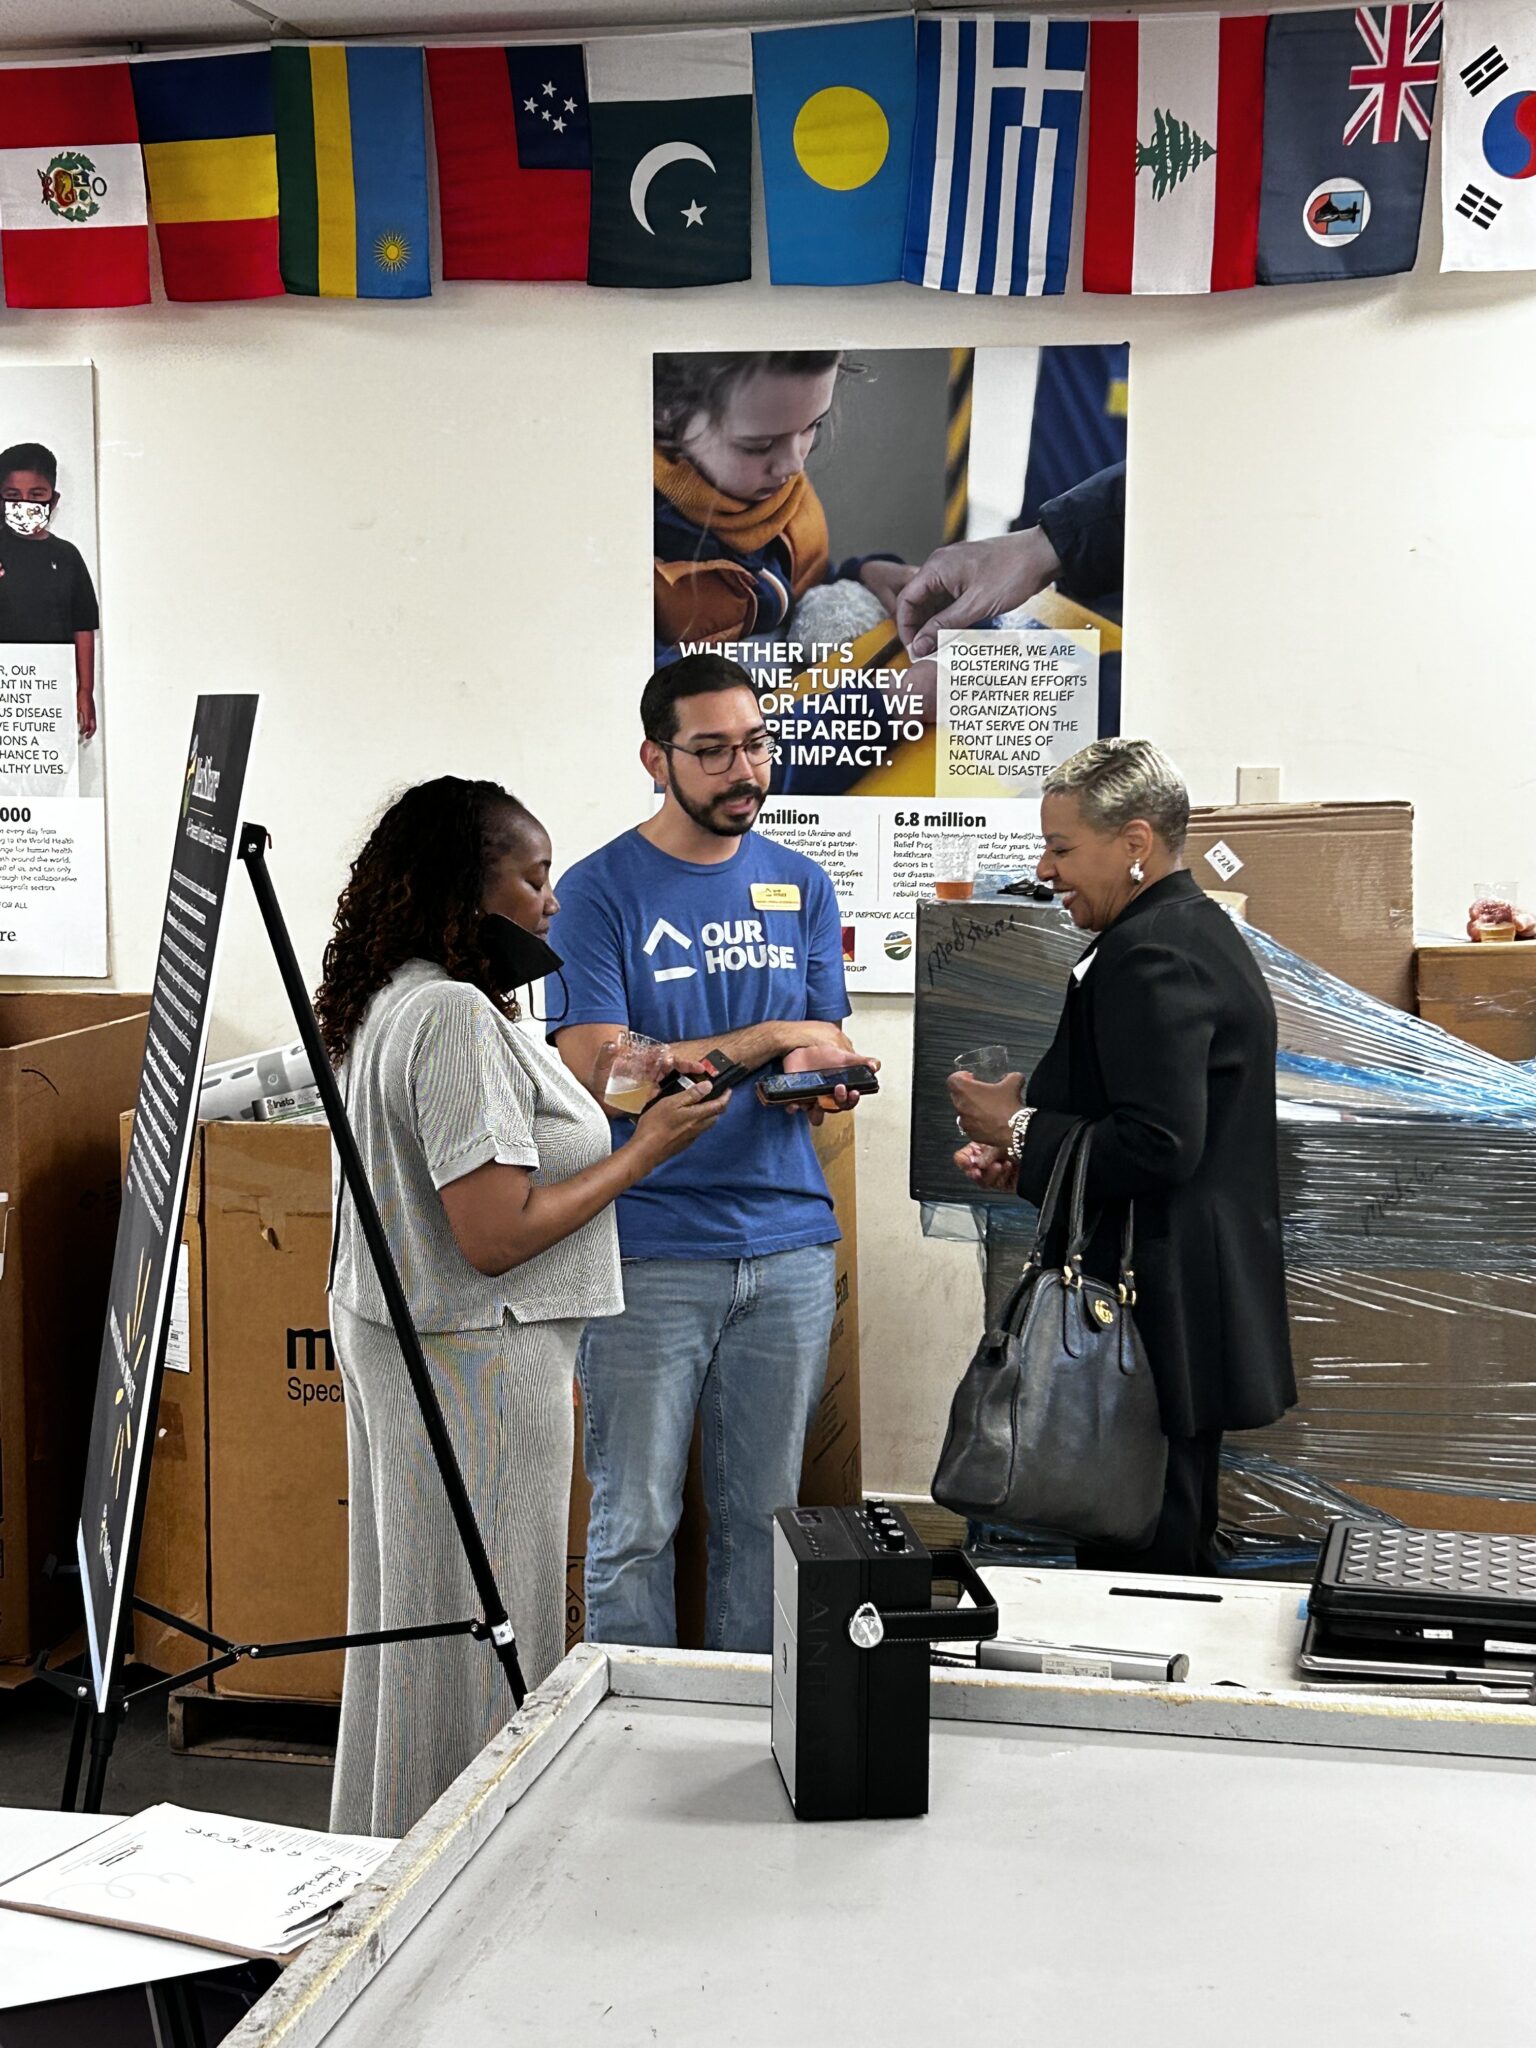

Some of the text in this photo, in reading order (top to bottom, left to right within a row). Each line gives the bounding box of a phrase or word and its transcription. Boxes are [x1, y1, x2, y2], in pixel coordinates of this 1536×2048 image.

[679, 641, 854, 664] WHETHER IT'S
[950, 645, 1076, 657] TOGETHER, WE ARE
[11, 665, 36, 676] OUR
[950, 660, 1059, 671] BOLSTERING THE
[20, 679, 32, 690] IN
[35, 679, 58, 690] THE
[807, 668, 913, 692] TURKEY,
[950, 675, 1087, 687] HERCULEAN EFFORTS
[950, 690, 1075, 701] OF PARTNER RELIEF
[758, 693, 924, 718] OR HAITI, WE
[949, 705, 1057, 716] ORGANIZATIONS
[16, 707, 62, 718] DISEASE
[13, 722, 56, 732] FUTURE
[888, 719, 924, 741] TO
[949, 720, 1079, 731] THAT SERVE ON THE
[31, 736, 39, 746] A
[949, 735, 1054, 746] FRONT LINES OF
[42, 750, 59, 760] TO
[790, 745, 893, 767] IMPACT.
[949, 750, 1040, 761] NATURAL AND
[949, 764, 995, 776] SOCIAL
[0, 807, 31, 822] 000
[759, 809, 820, 825] million
[894, 811, 986, 827] 6.8 million
[702, 919, 765, 947] OUR
[705, 943, 797, 974] HOUSE
